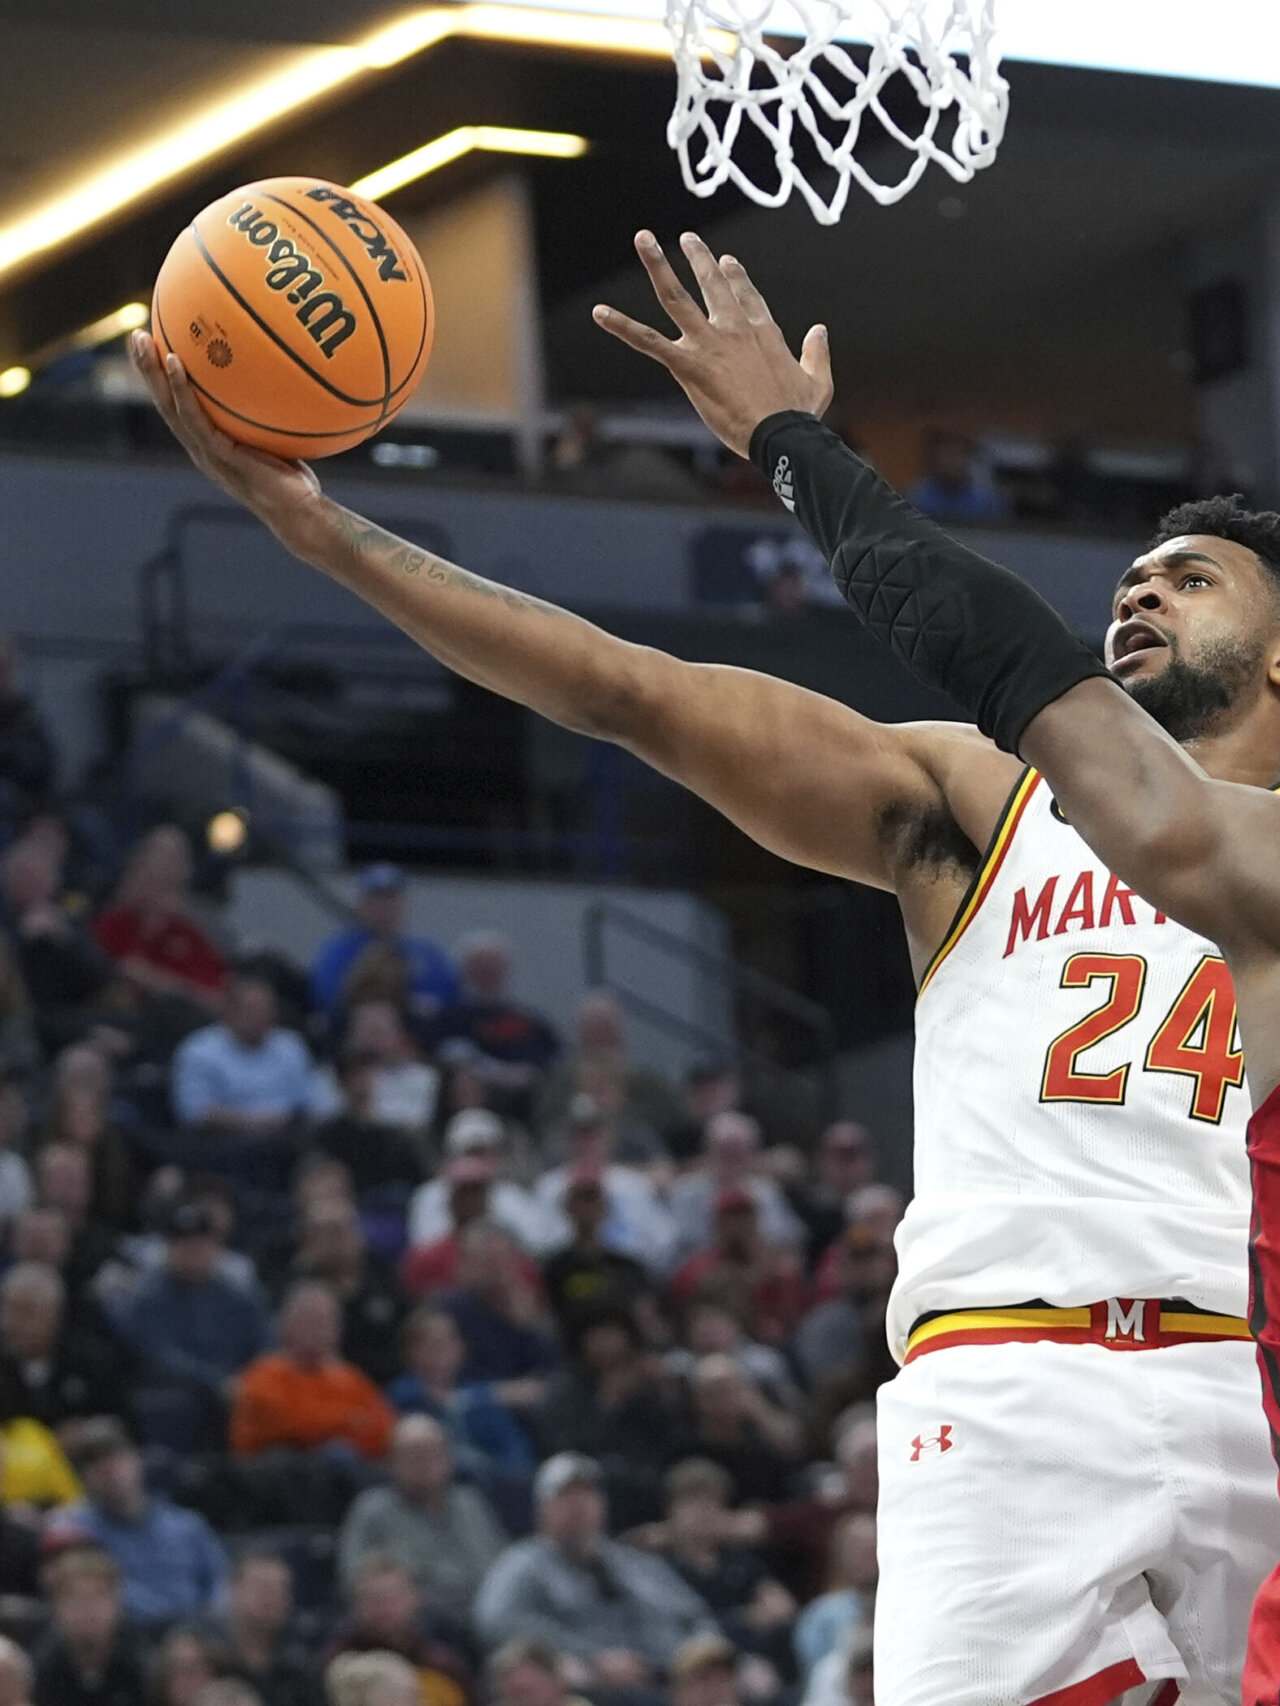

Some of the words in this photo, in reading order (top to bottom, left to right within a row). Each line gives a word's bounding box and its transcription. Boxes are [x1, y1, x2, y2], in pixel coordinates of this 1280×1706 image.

[227, 201, 357, 360] Wilson
[306, 185, 407, 283] NCAA
[1003, 871, 1168, 959] MAR
[1039, 952, 1245, 1124] 24
[1104, 1297, 1146, 1342] M
